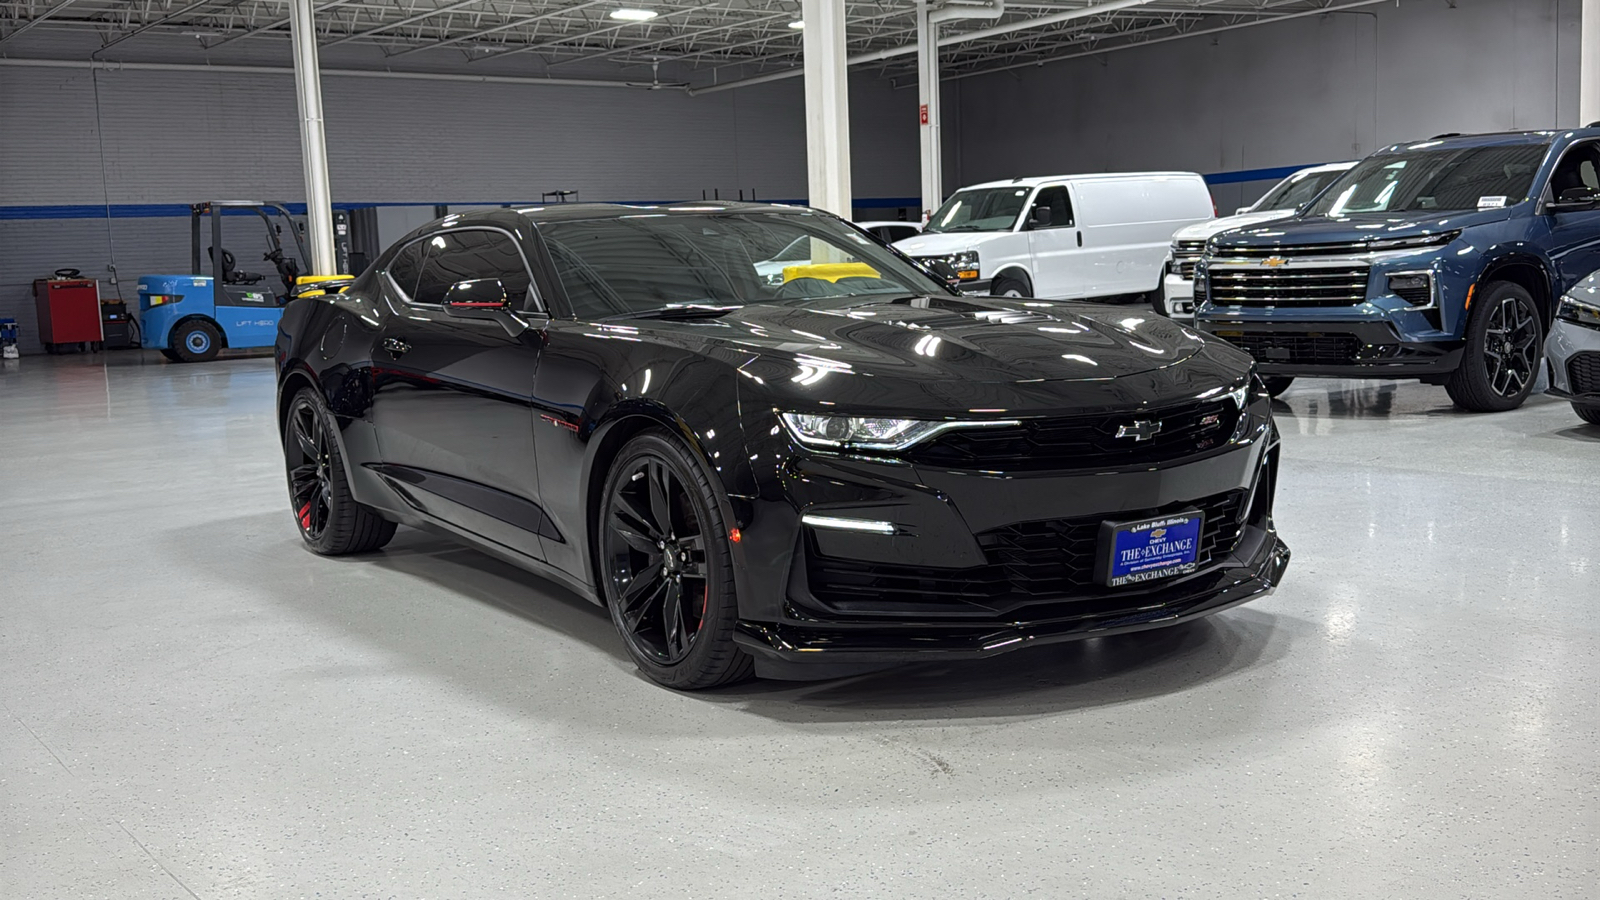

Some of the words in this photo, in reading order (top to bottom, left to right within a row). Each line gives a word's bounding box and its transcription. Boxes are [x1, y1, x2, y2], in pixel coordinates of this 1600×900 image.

[1167, 517, 1184, 525] Illinois
[1121, 547, 1141, 561] THE
[1145, 538, 1193, 558] EXCHANGE
[1112, 576, 1128, 587] THE
[1135, 566, 1179, 582] EXCHANGE
